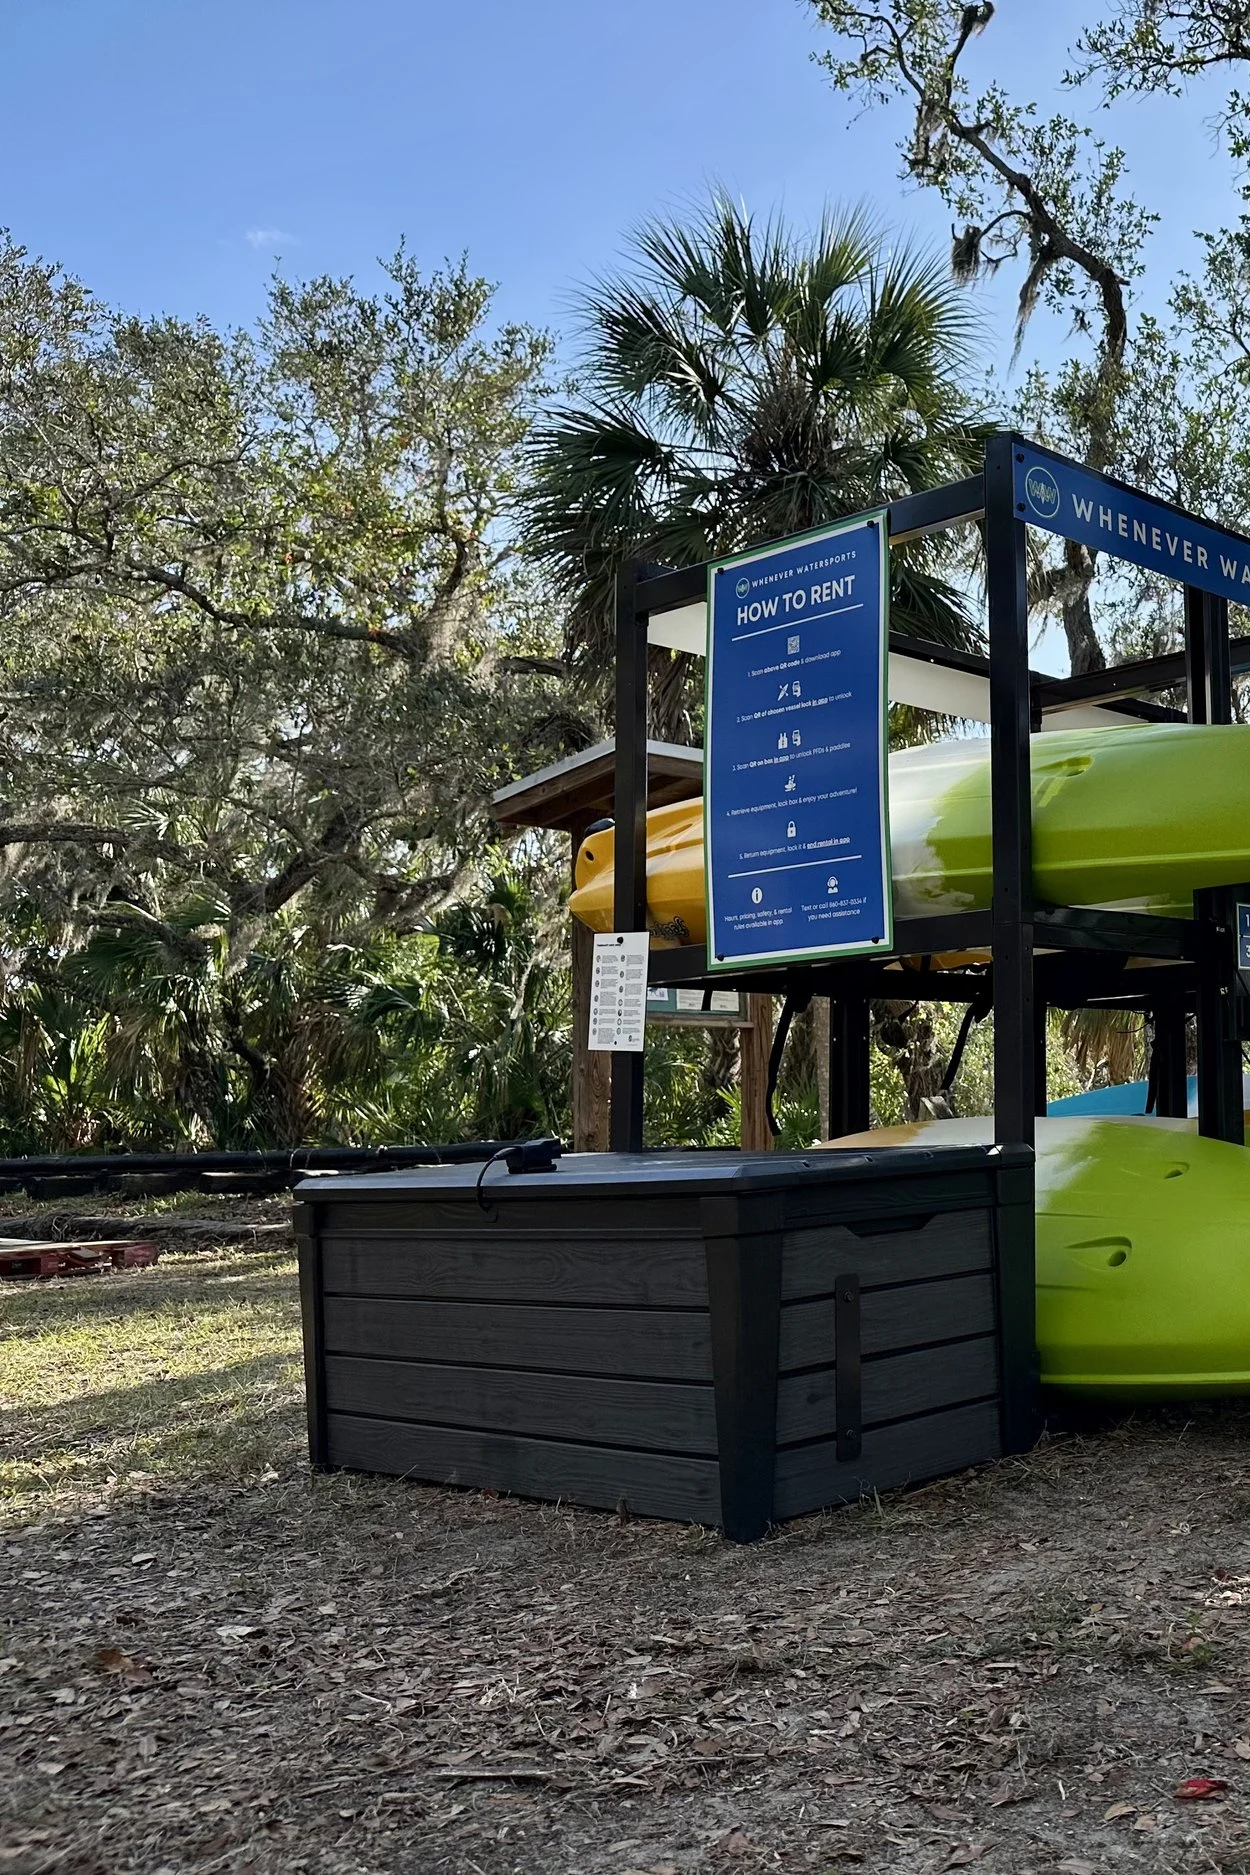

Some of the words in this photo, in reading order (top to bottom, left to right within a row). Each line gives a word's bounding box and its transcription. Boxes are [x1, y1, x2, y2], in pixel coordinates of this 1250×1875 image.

[1071, 492, 1209, 570] WHENEVER
[751, 569, 794, 588] WHENEVER
[796, 551, 856, 575] WATERSPORTS
[737, 596, 779, 626] HOW
[782, 590, 807, 613] TO
[810, 575, 856, 606] RENT
[751, 668, 764, 677] Scan
[764, 665, 780, 674] above
[779, 662, 788, 670] QR
[787, 659, 801, 668] code
[804, 651, 830, 664] download
[830, 649, 842, 658] app
[741, 714, 754, 722] Scan
[753, 711, 761, 719] QR
[767, 706, 786, 716] chosen
[785, 702, 801, 712] vessel
[817, 697, 829, 707] app
[835, 690, 853, 701] unlock
[736, 763, 749, 771] Scan
[779, 755, 790, 763] app
[795, 750, 812, 759] unlock
[812, 747, 825, 755] PFDs
[829, 742, 851, 753] paddles
[731, 807, 750, 816] Retrieve
[777, 800, 789, 808] lock
[788, 798, 798, 806] box
[802, 795, 817, 804] enjoy
[817, 792, 829, 801] your
[829, 787, 858, 798] adventure!
[744, 851, 760, 859] Return
[787, 844, 798, 852] lock
[806, 841, 817, 849] end
[817, 838, 833, 848] rental
[839, 836, 851, 845] app
[777, 906, 792, 915] rental
[800, 904, 812, 912] Text
[807, 913, 818, 922] you
[818, 911, 832, 919] need
[832, 908, 860, 918] assistance
[1245, 914, 1250, 927] 1
[733, 922, 745, 930] rules
[745, 920, 768, 929] available
[772, 918, 784, 927] app
